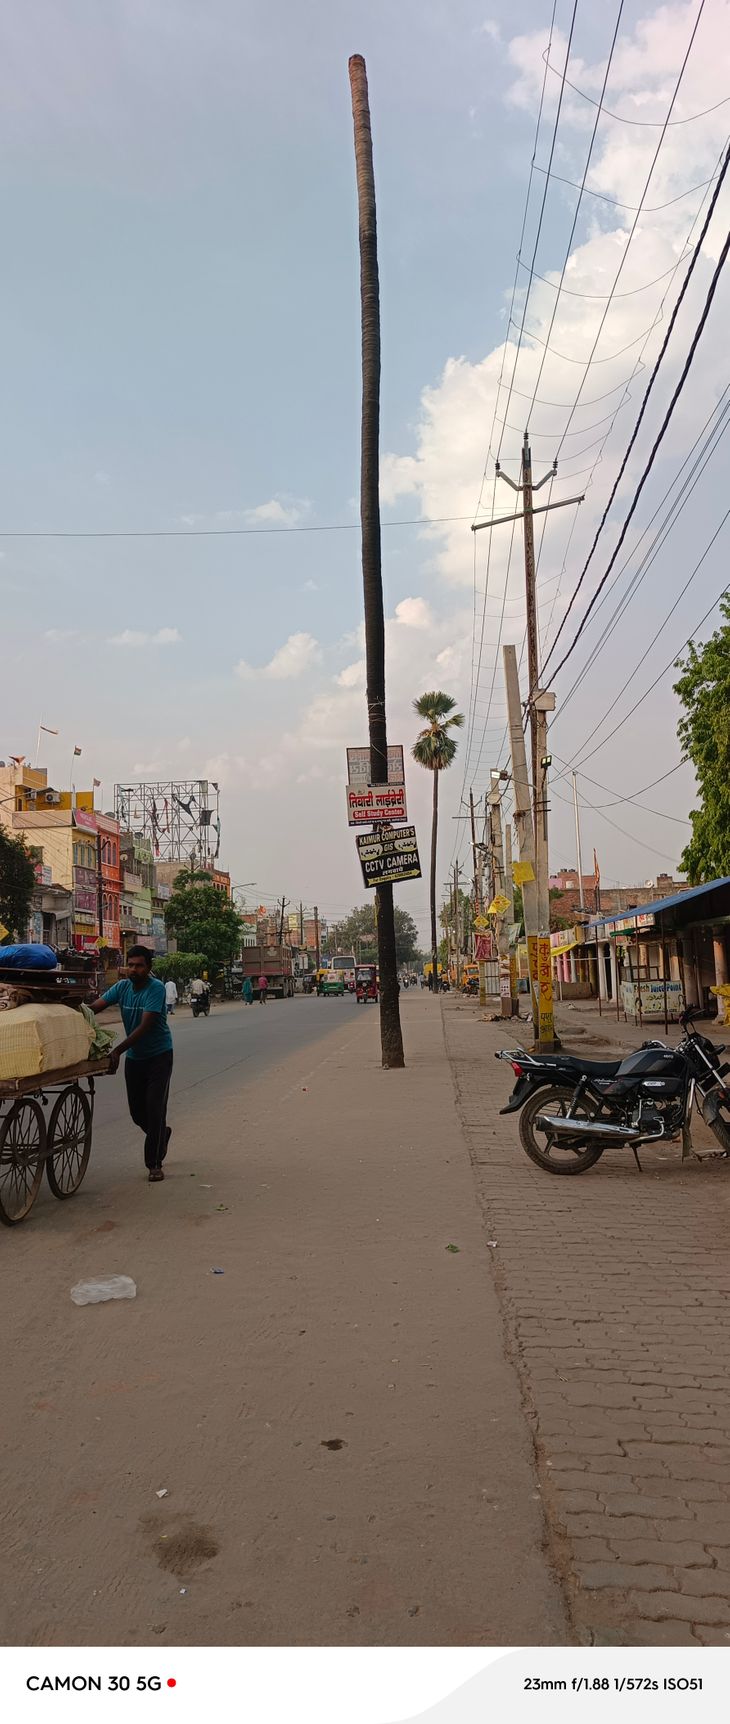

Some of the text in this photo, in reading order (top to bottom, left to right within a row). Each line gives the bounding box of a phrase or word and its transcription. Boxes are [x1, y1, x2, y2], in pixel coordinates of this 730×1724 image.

[349, 790, 373, 808] तिवारी
[367, 809, 383, 818] Study
[384, 808, 403, 816] Center
[359, 833, 381, 846] KAIMUR
[365, 853, 419, 873] CCTV CAMERA
